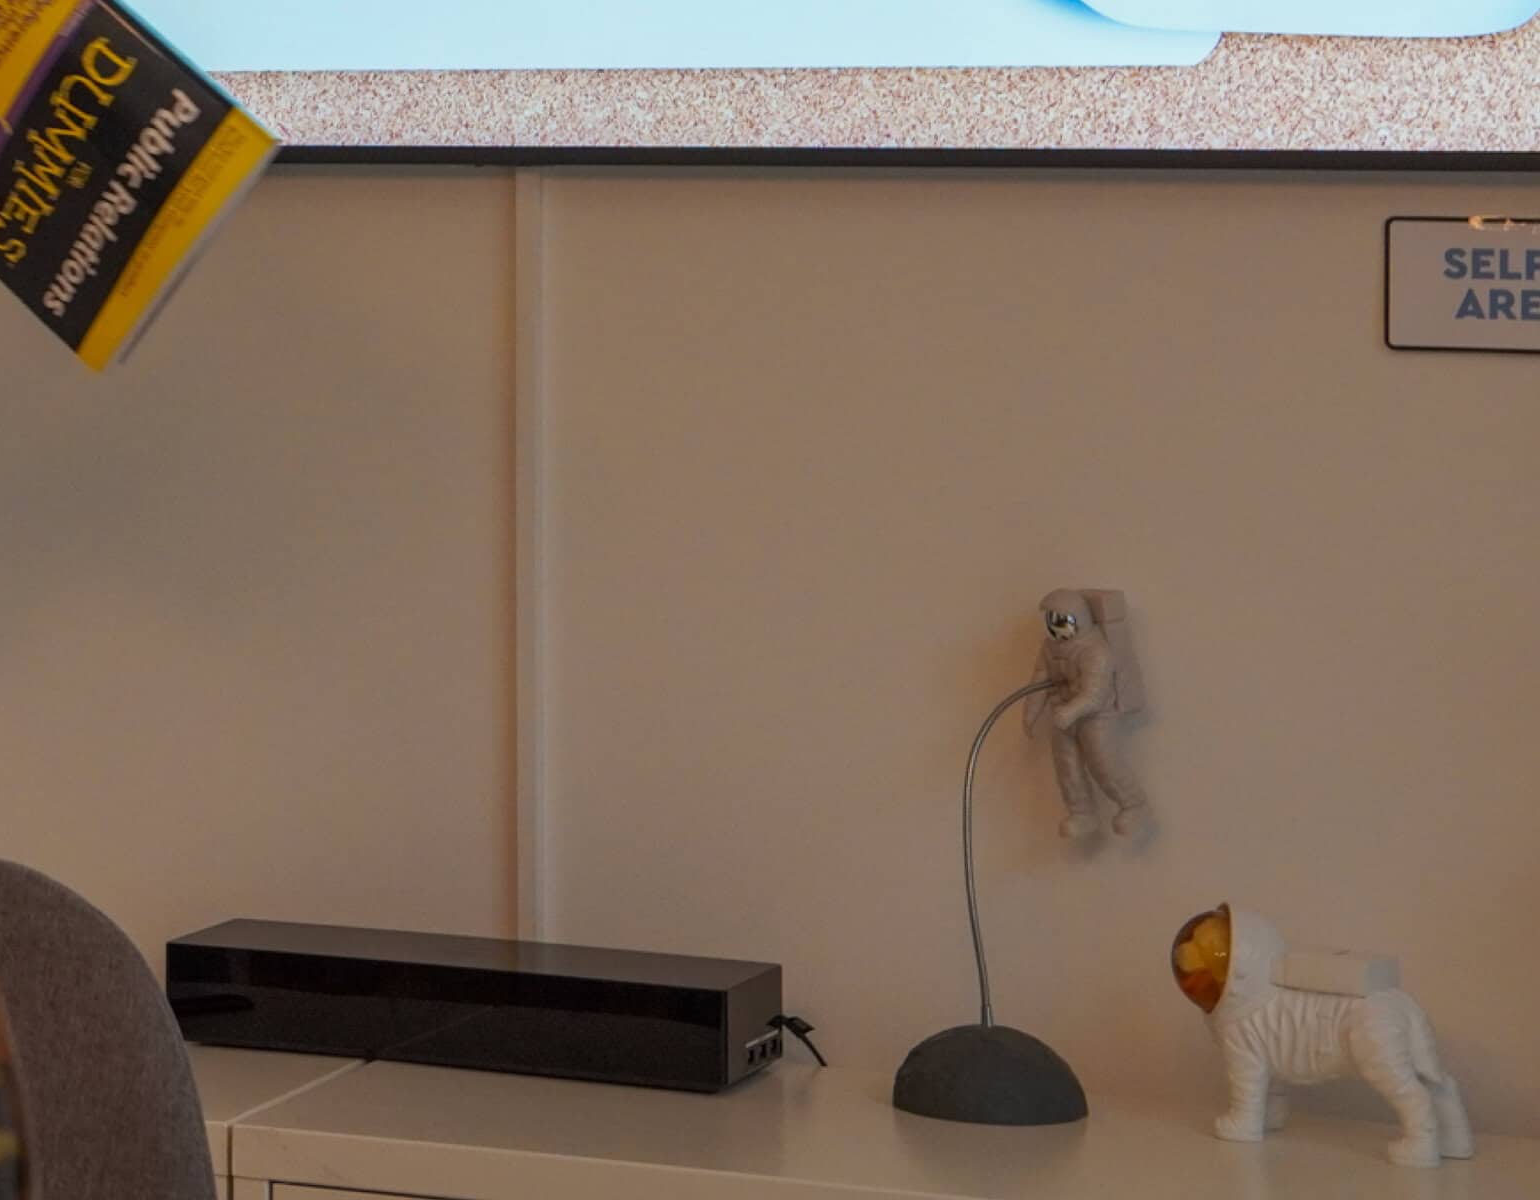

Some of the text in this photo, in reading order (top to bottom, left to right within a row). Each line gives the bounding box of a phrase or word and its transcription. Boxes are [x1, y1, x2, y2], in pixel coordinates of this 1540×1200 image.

[117, 88, 200, 187] Public
[44, 180, 135, 315] Relations
[1454, 288, 1540, 321] ARE
